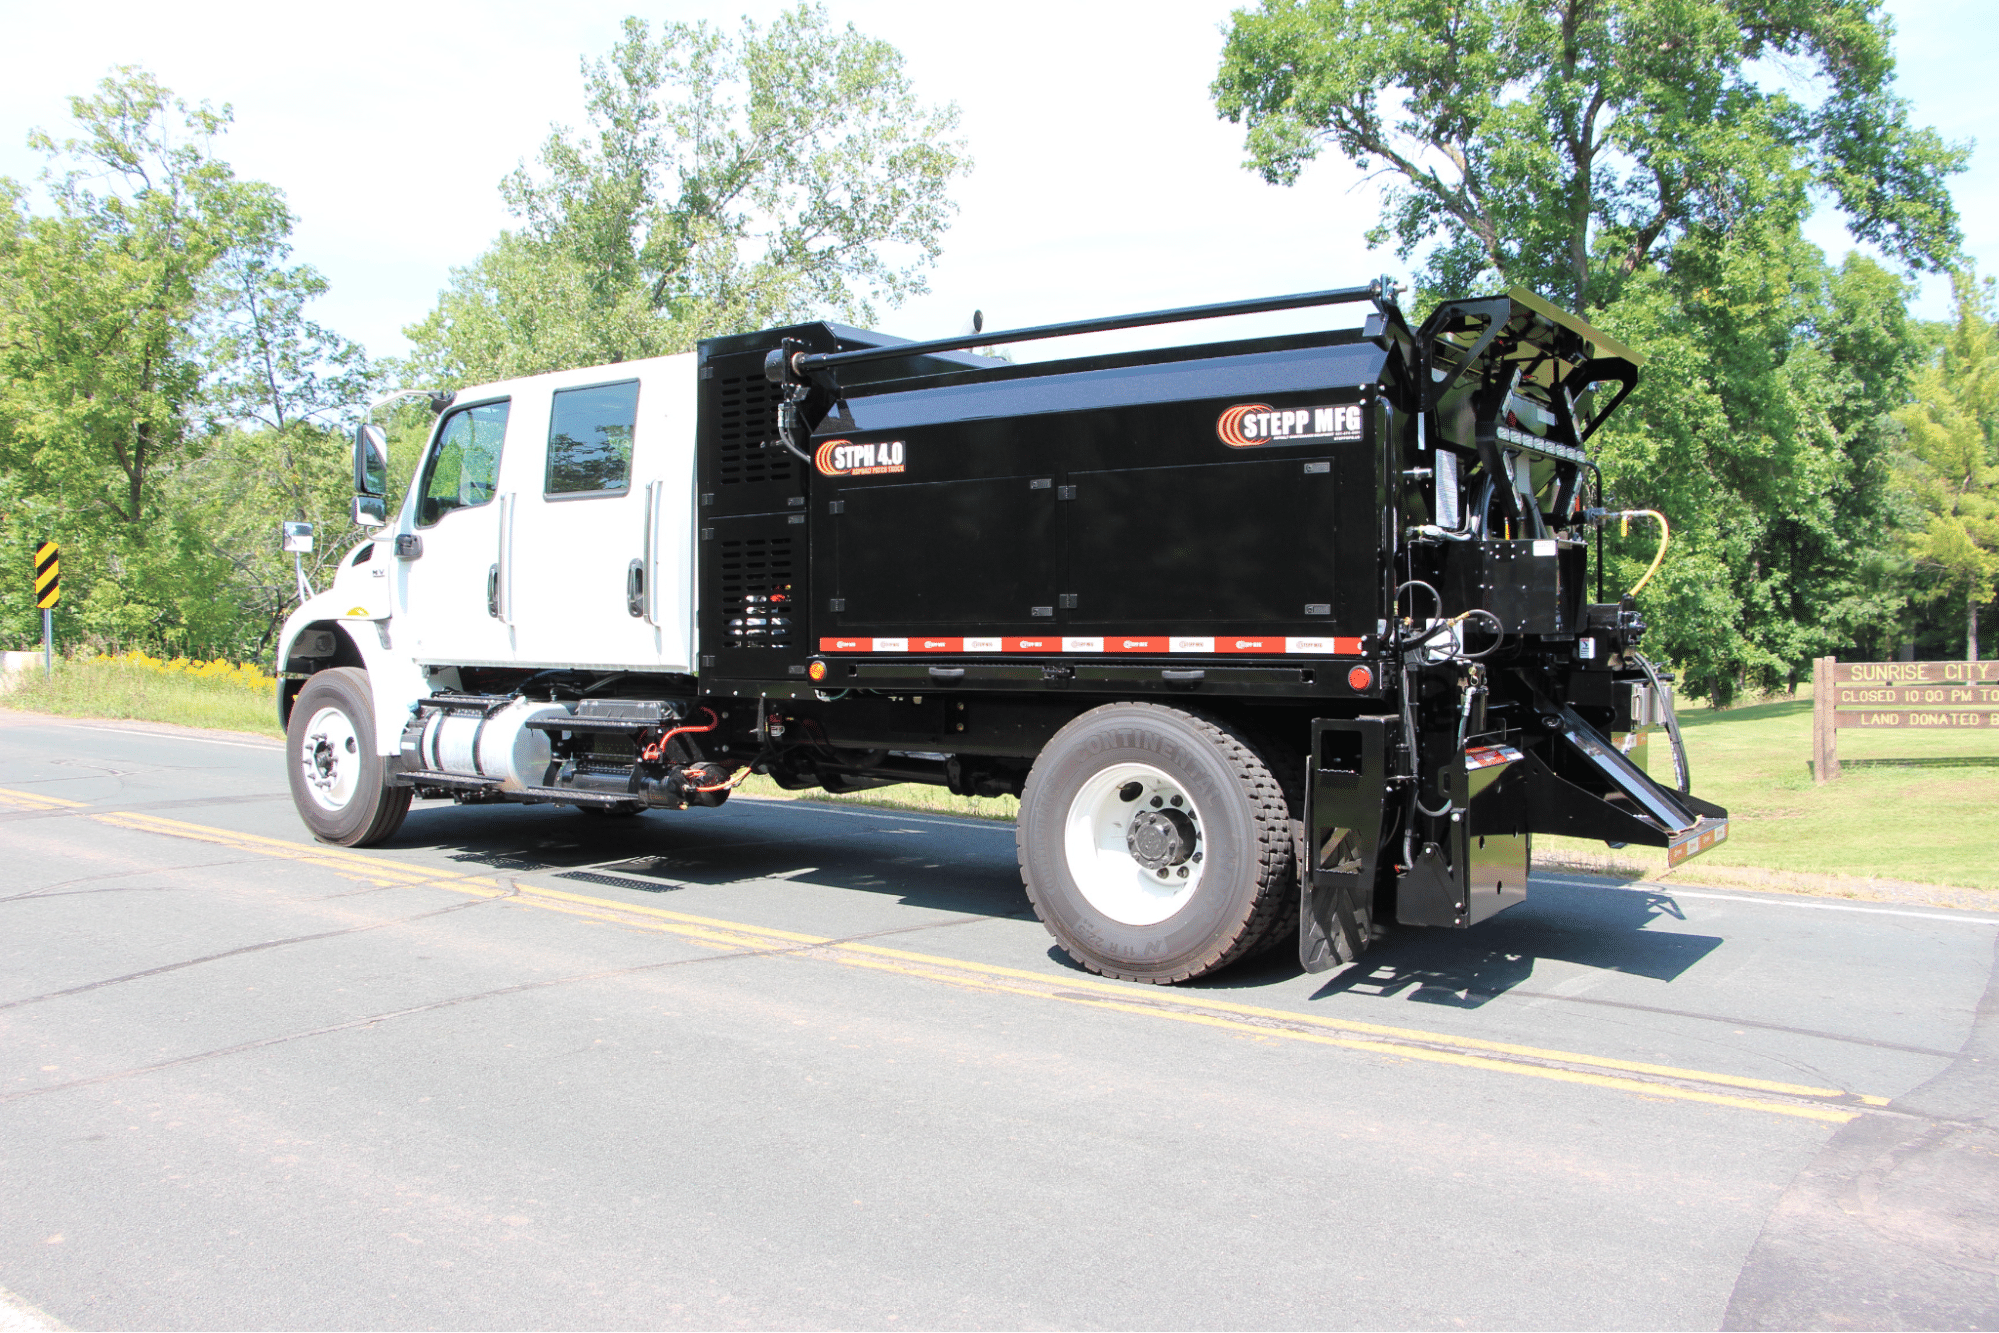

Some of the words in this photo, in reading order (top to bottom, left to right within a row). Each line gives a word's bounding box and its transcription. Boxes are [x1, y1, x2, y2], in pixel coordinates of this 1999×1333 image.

[1243, 409, 1310, 438] STEPP
[1314, 405, 1361, 433] MFG
[834, 443, 875, 469] STPH
[877, 441, 903, 466] 4.0
[1850, 663, 1930, 681] SUNRISE
[1944, 663, 1990, 680] CITY
[1841, 690, 1896, 703] CLOSED
[1905, 689, 1944, 703] 10:00
[1951, 689, 1972, 702] PM
[1861, 713, 1900, 726] LAND
[1909, 713, 1980, 726] DONATED
